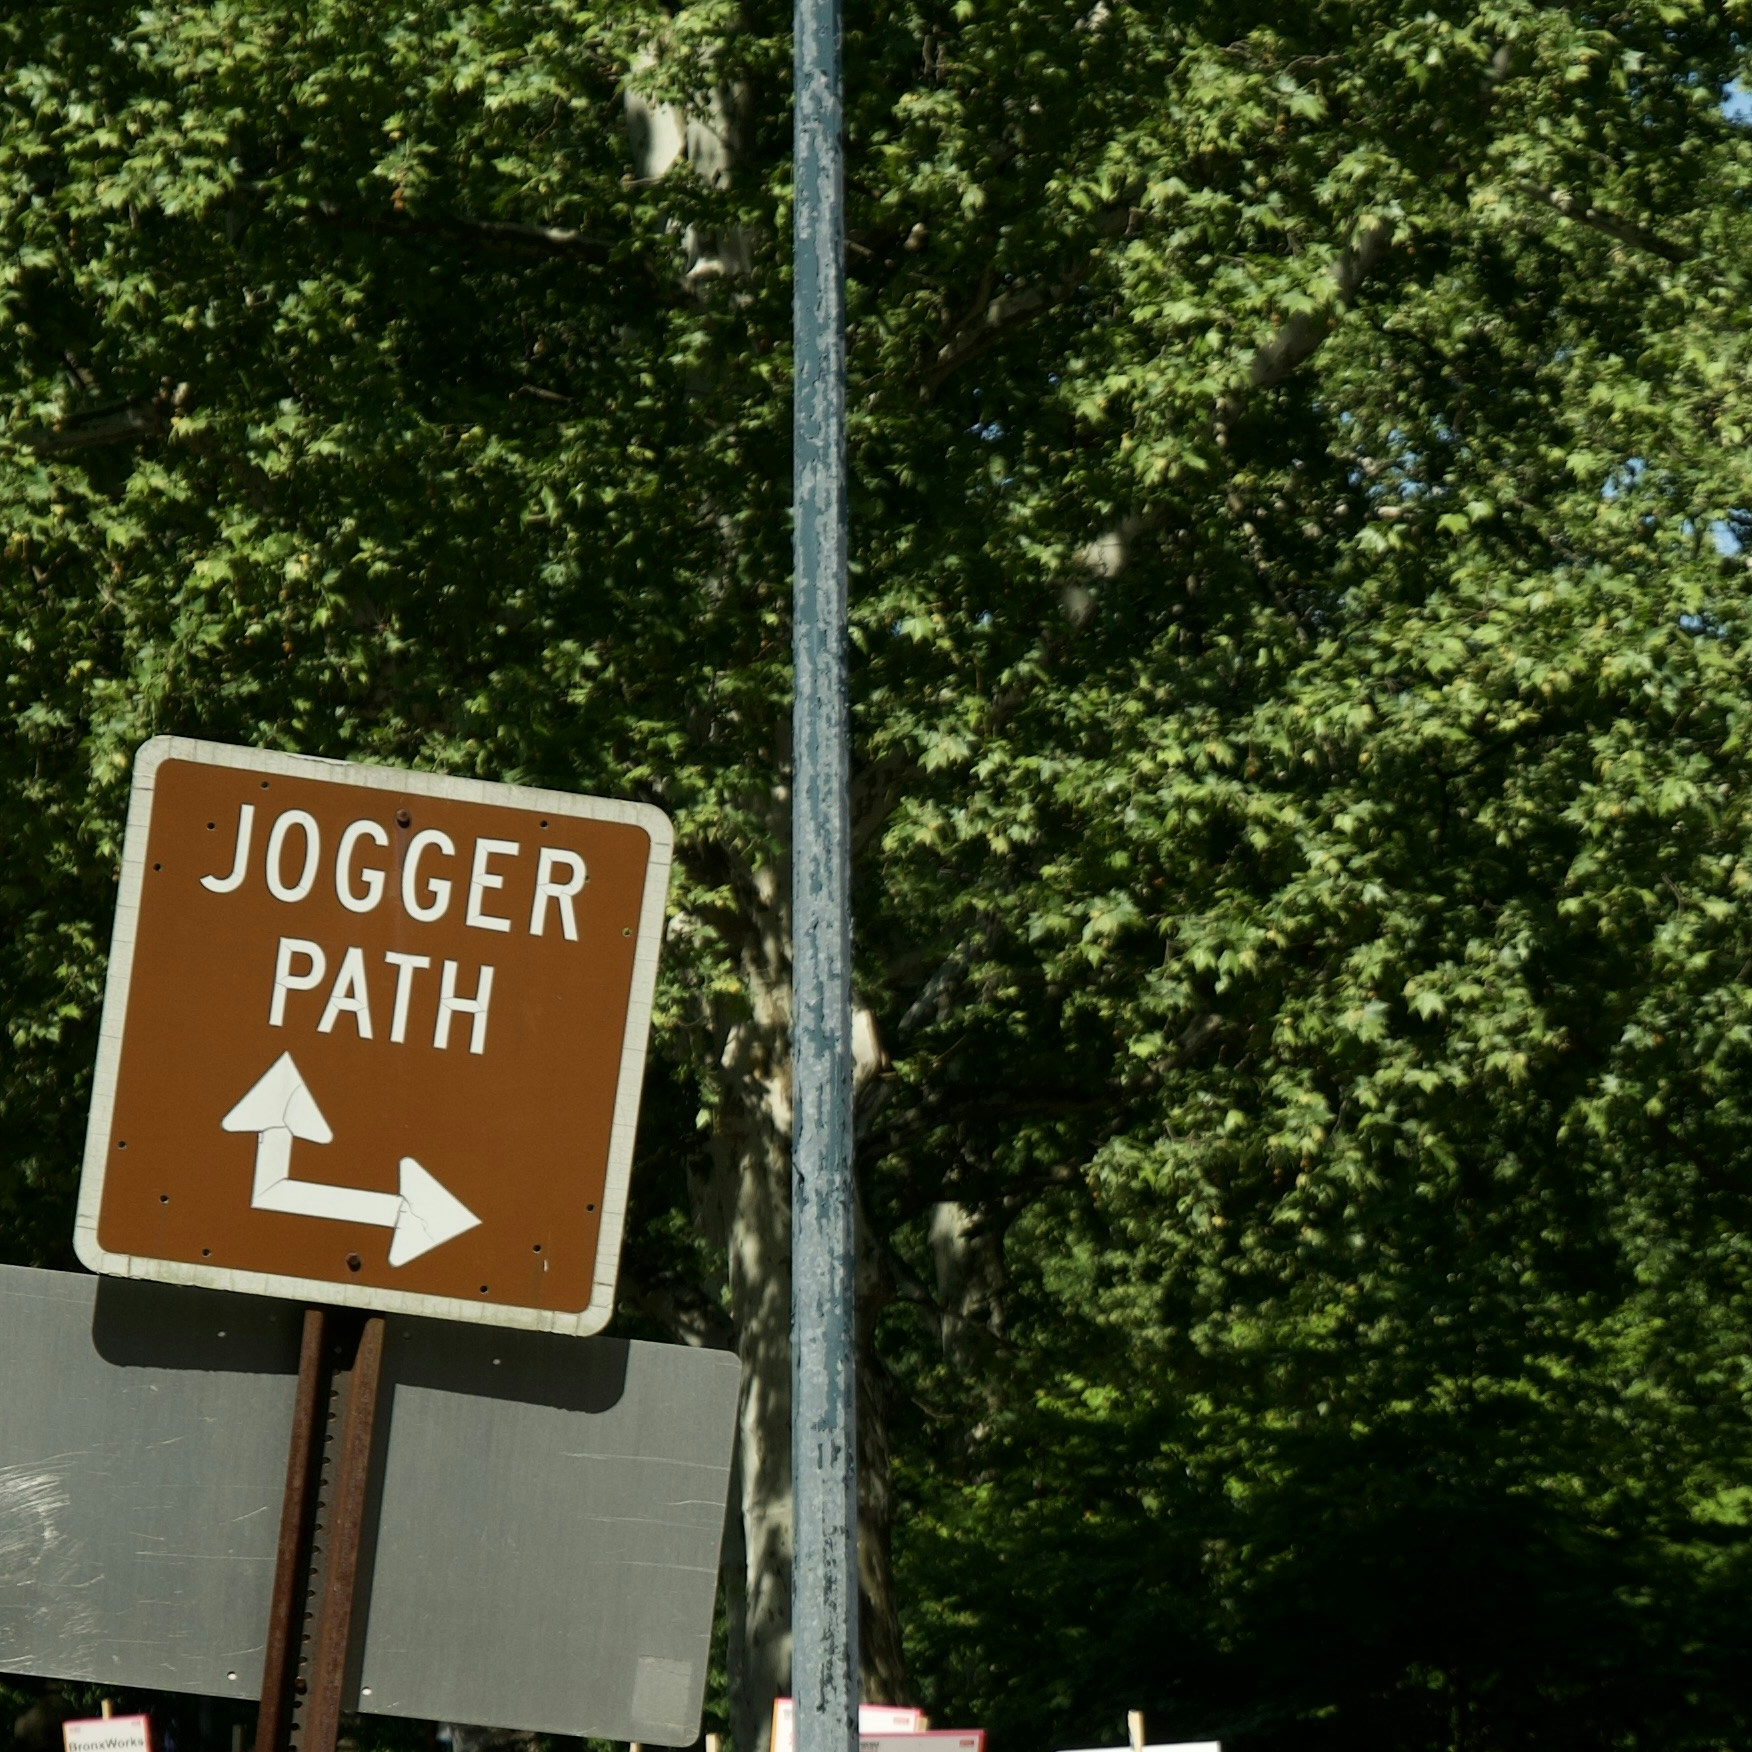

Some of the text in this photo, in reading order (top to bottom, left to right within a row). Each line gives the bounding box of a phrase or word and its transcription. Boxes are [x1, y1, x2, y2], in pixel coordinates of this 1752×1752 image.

[201, 803, 588, 942] JOGGER
[269, 937, 496, 1055] PATH
[69, 1737, 144, 1752] BronxWorks
